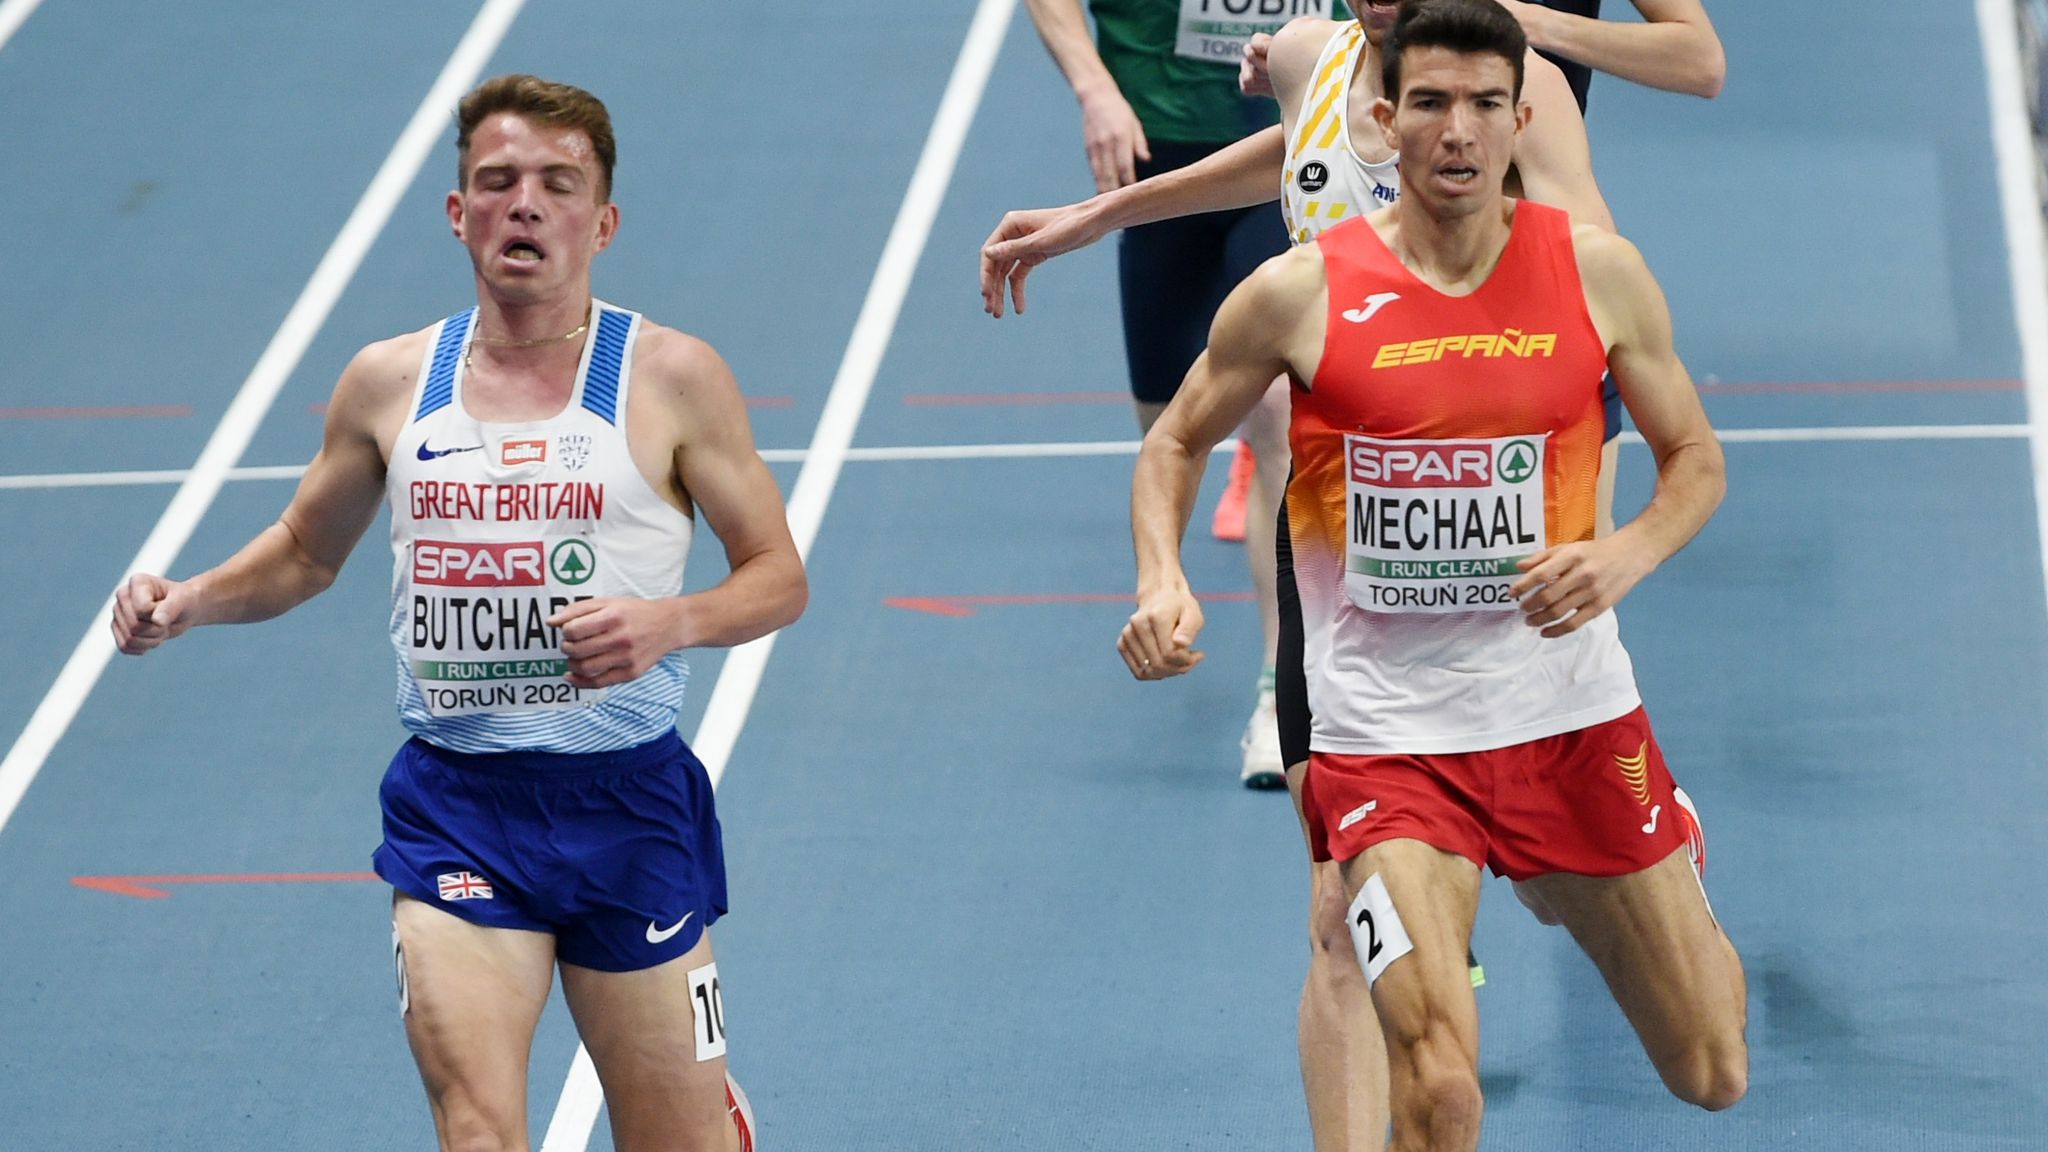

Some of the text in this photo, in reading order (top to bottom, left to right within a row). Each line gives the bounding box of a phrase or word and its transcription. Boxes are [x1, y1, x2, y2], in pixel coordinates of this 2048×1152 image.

[1371, 328, 1557, 369] ESPAÑA
[1351, 449, 1489, 482] SPAR
[410, 480, 604, 522] GREAT BRITAIN
[1353, 492, 1536, 551] MECHAAL
[415, 545, 543, 581] SPAR
[1381, 562, 1387, 576] I
[1391, 562, 1432, 577] RUN
[1368, 582, 1521, 607] TORUŃ 202
[437, 663, 444, 678] I
[447, 663, 487, 679] RUN
[427, 683, 516, 709] TORUŃ
[1357, 909, 1383, 964] 2
